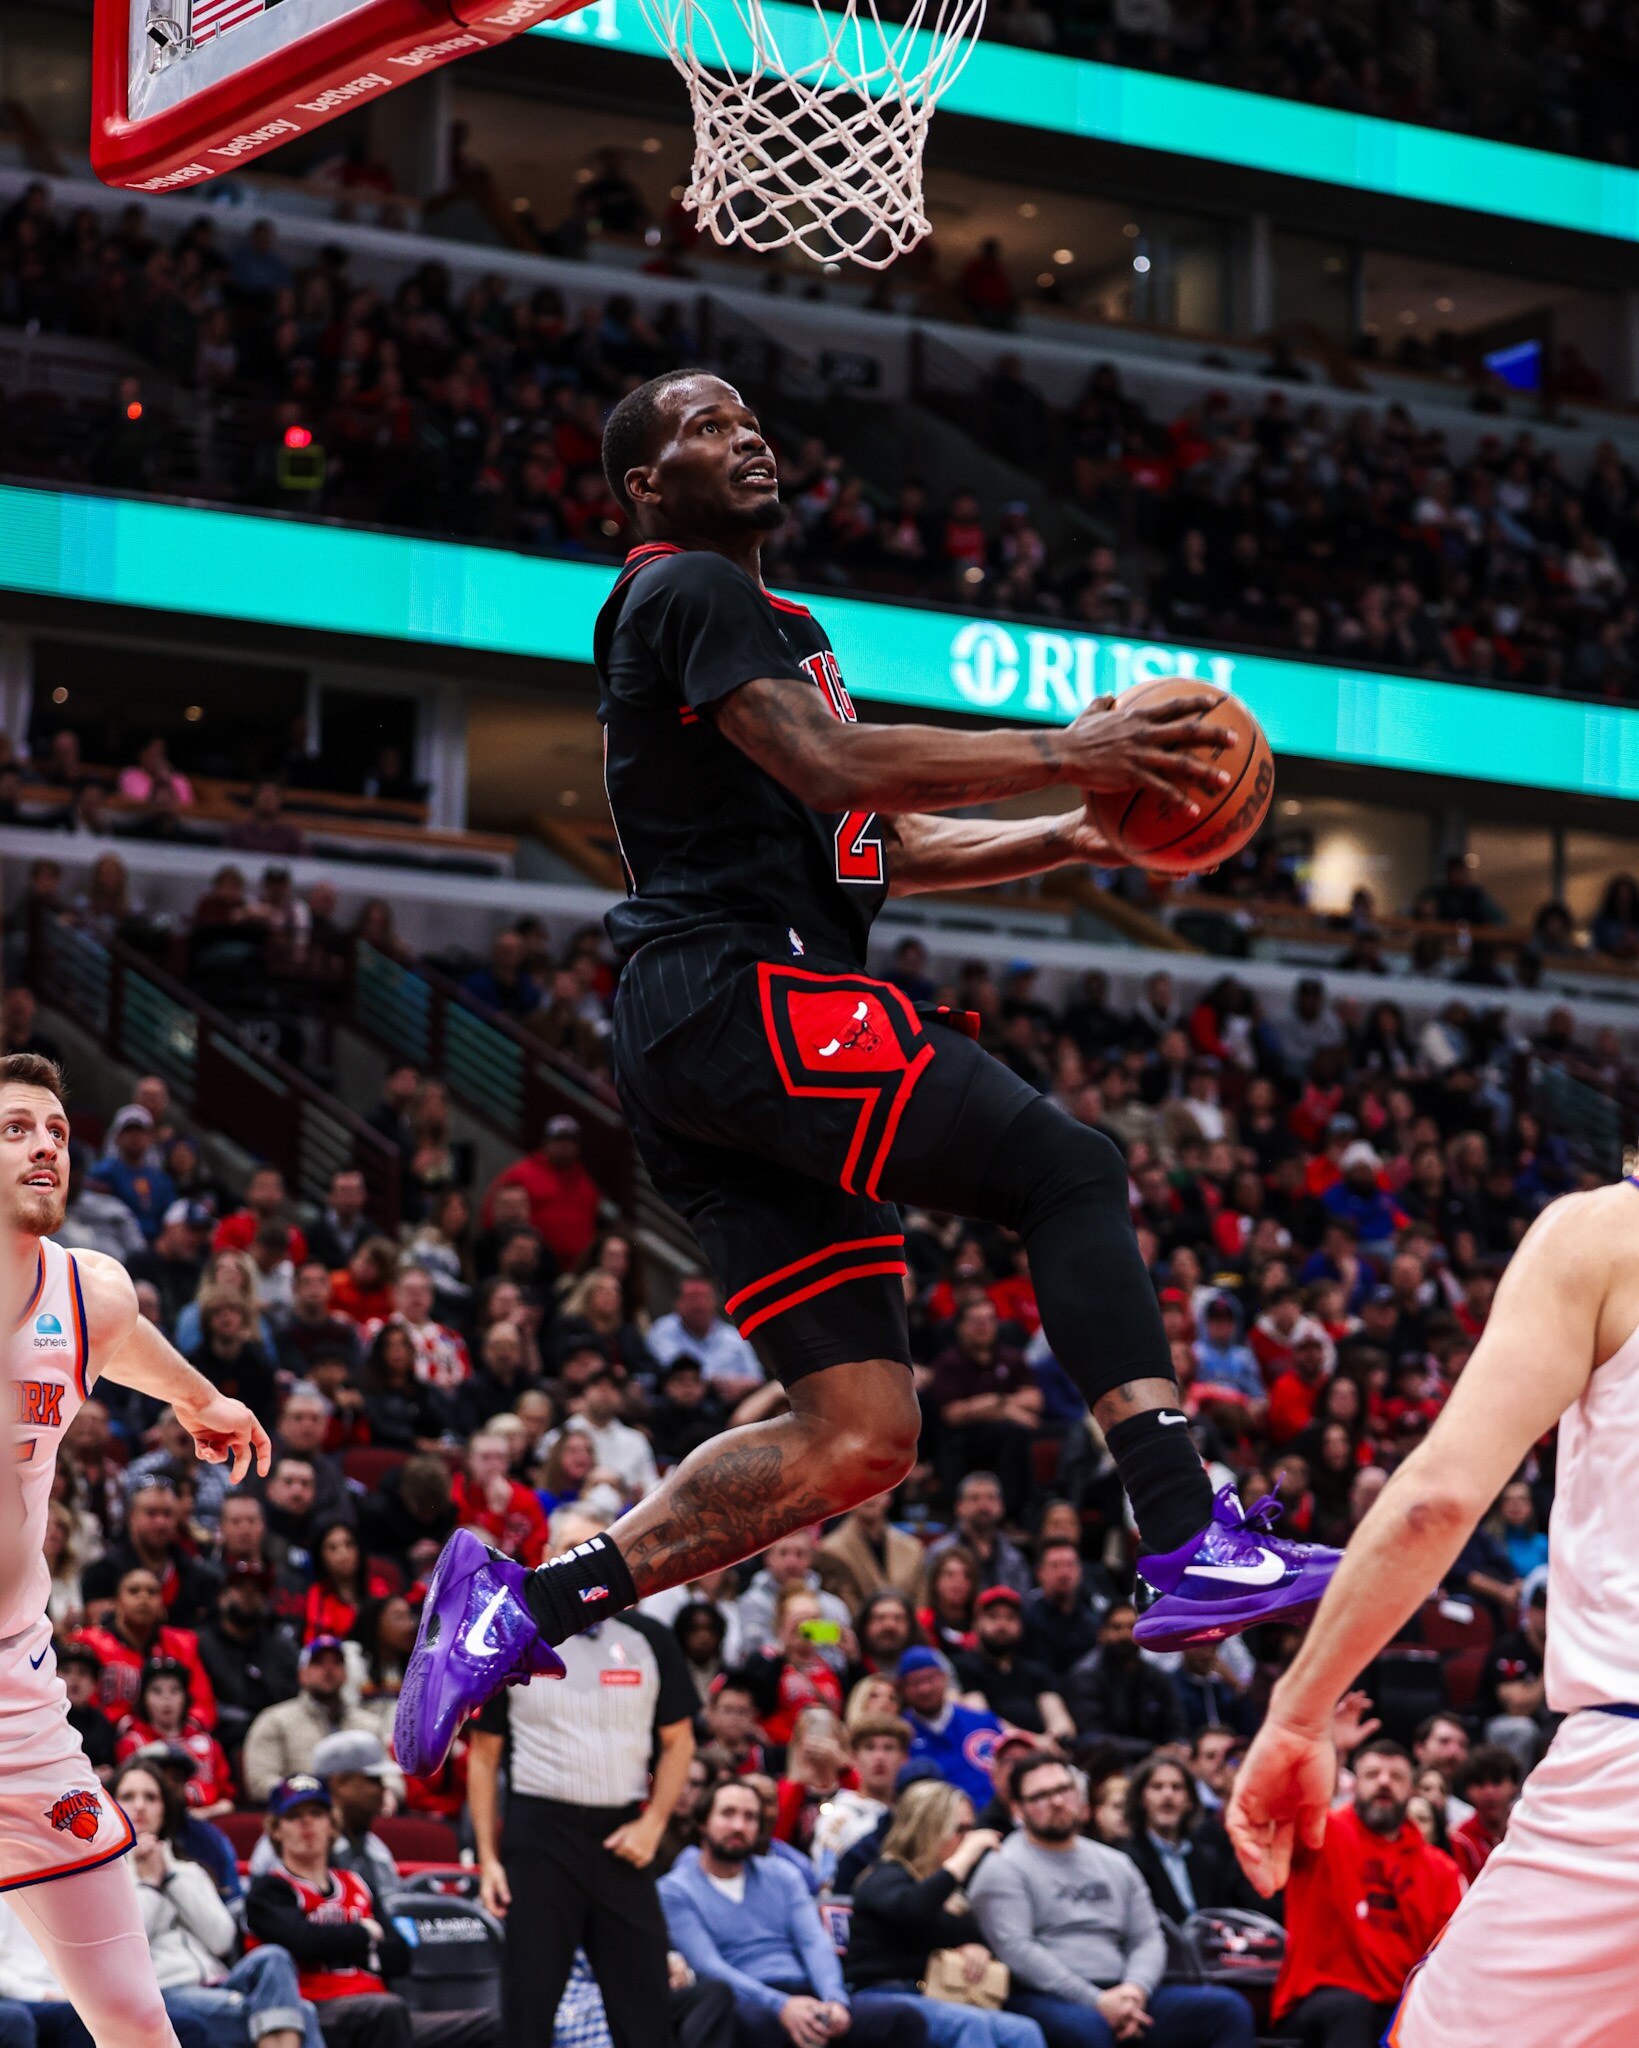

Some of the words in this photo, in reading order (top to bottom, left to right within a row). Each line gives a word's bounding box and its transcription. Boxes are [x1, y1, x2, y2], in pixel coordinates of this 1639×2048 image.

[125, 162, 214, 190] betway
[207, 118, 301, 157] betway
[295, 72, 392, 112] betway
[387, 33, 488, 67] betway
[483, 0, 552, 26] bet
[33, 1337, 67, 1347] sphere
[51, 1790, 102, 1829] KNICKS
